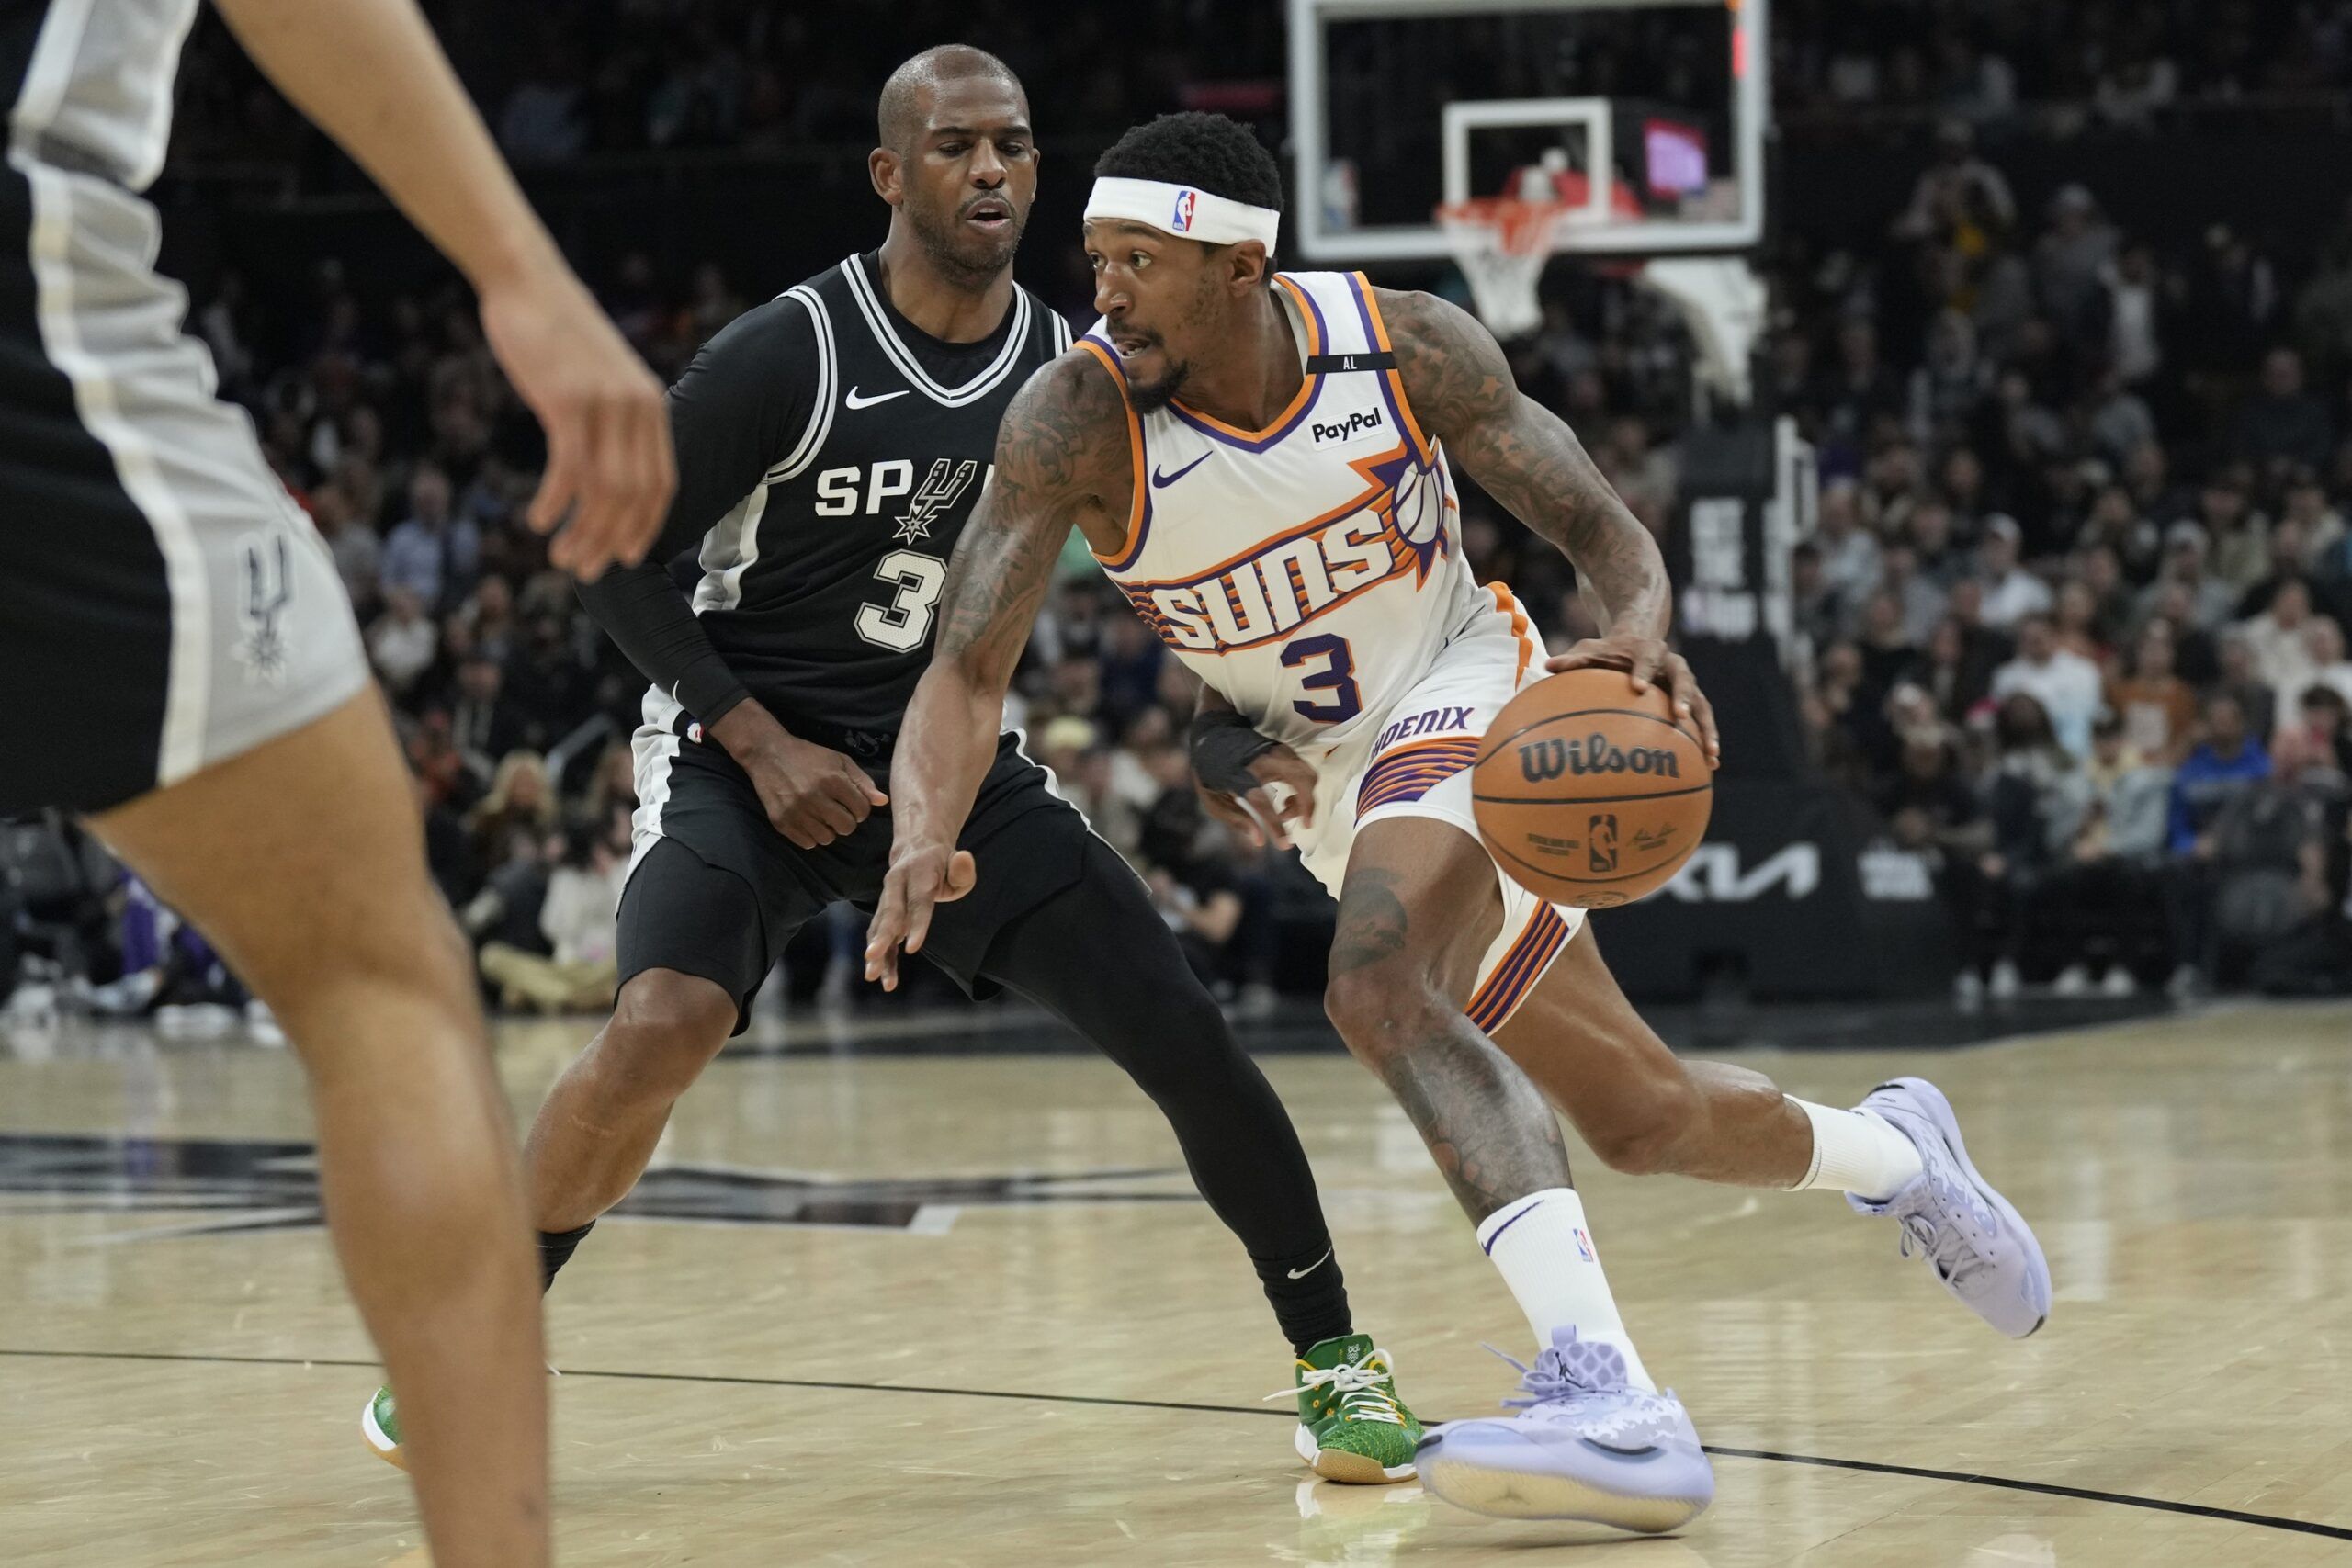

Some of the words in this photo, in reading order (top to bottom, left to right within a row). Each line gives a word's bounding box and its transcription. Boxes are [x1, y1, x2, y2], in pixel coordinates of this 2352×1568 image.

[1343, 356, 1357, 370] AL
[1312, 407, 1382, 443] PayPal
[854, 549, 948, 654] 3
[1280, 633, 1363, 724] 3
[1518, 732, 1680, 783] Wilson
